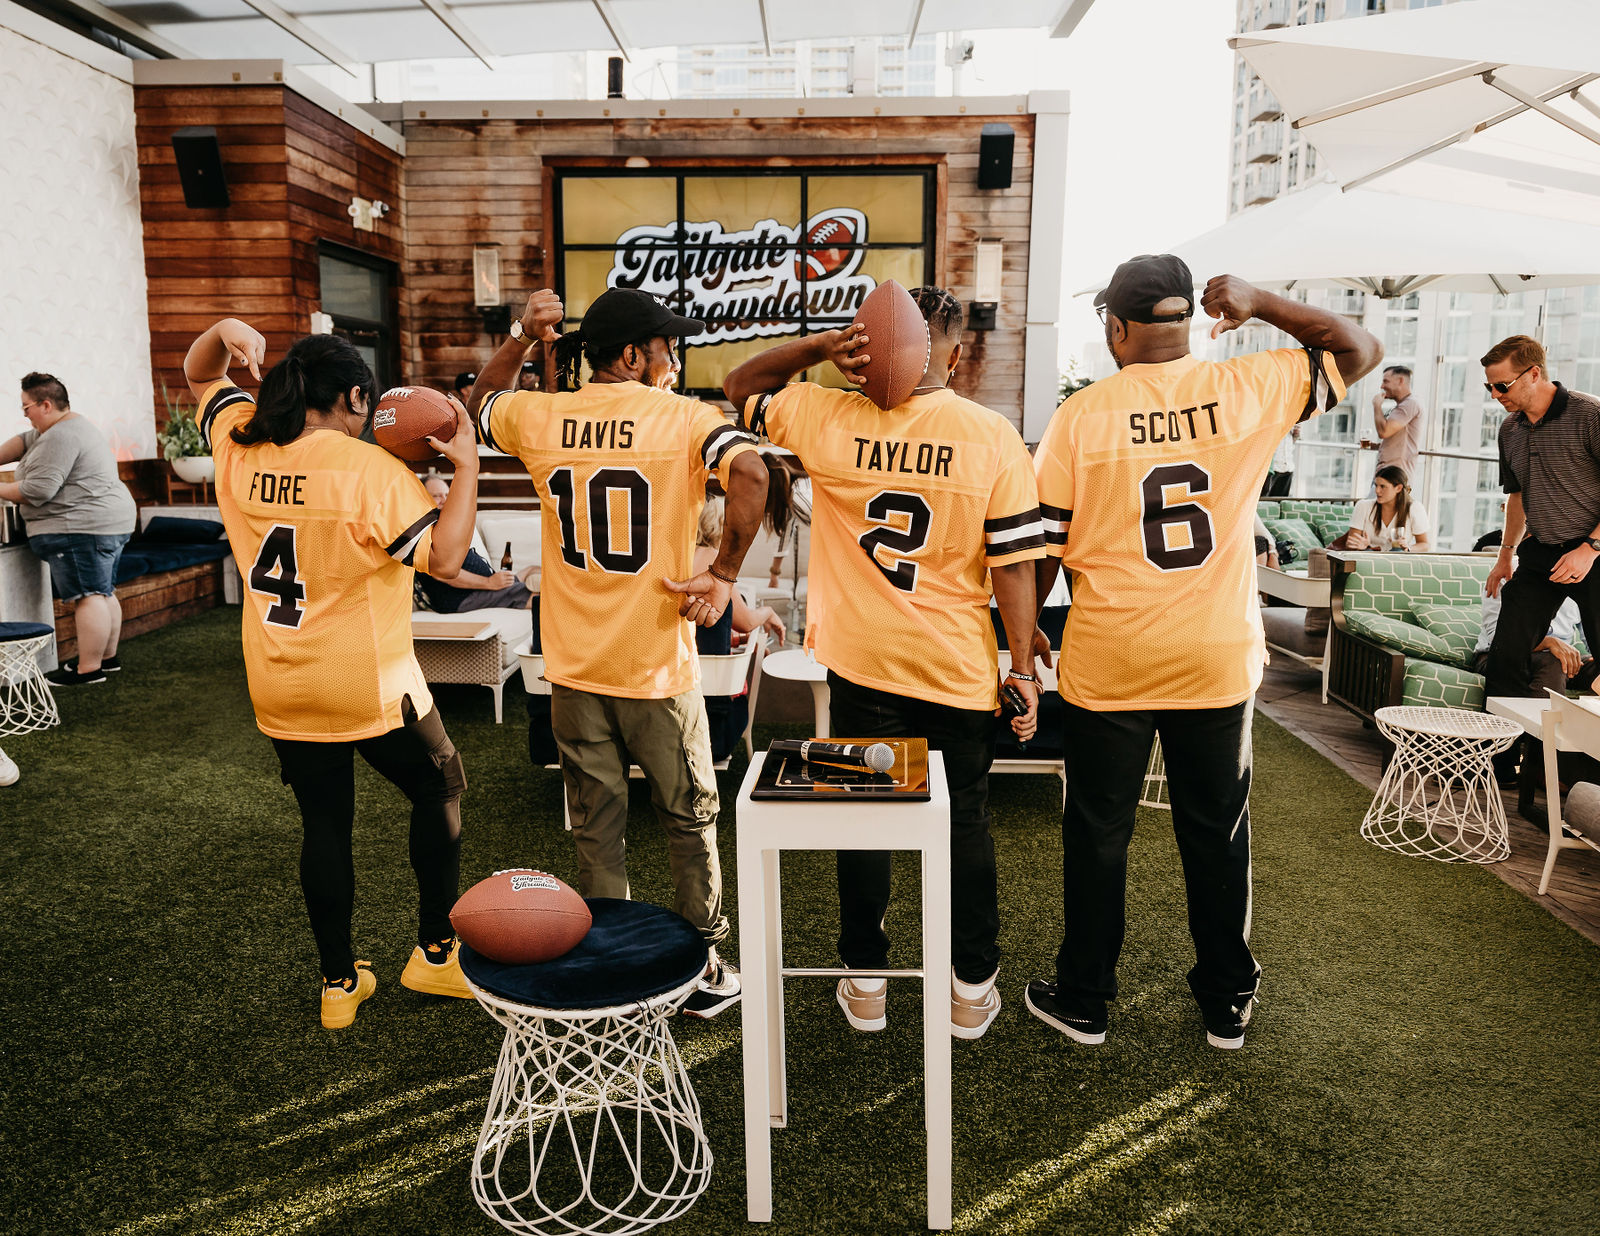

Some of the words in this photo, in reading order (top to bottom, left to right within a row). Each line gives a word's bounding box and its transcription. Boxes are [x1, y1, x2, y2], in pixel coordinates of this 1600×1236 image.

[561, 418, 635, 450] DAVIS
[854, 437, 954, 478] TAYLOR
[1130, 402, 1220, 445] SCOTT
[248, 472, 307, 506] FORE
[546, 466, 652, 576] 10
[1139, 460, 1217, 574] 6
[248, 524, 307, 630] 4
[857, 490, 934, 594] 2
